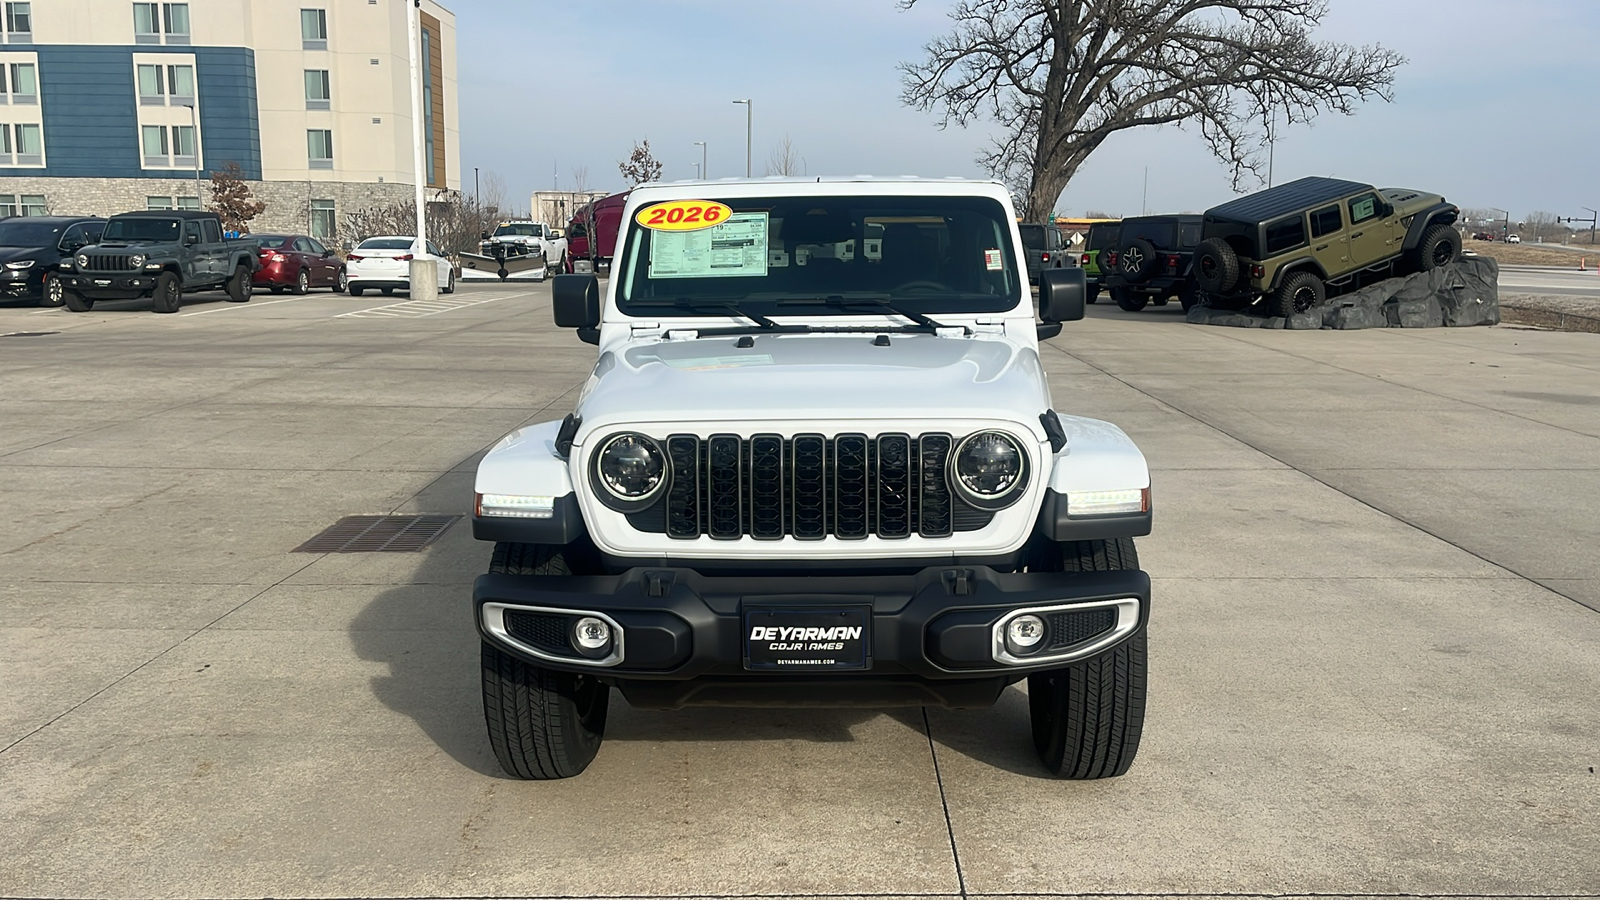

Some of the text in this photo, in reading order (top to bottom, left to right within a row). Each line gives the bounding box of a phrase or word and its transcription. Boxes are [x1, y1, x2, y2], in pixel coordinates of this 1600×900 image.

[647, 205, 722, 225] 2026
[750, 626, 863, 641] DEYARMAN
[769, 642, 845, 651] CDJR AMES
